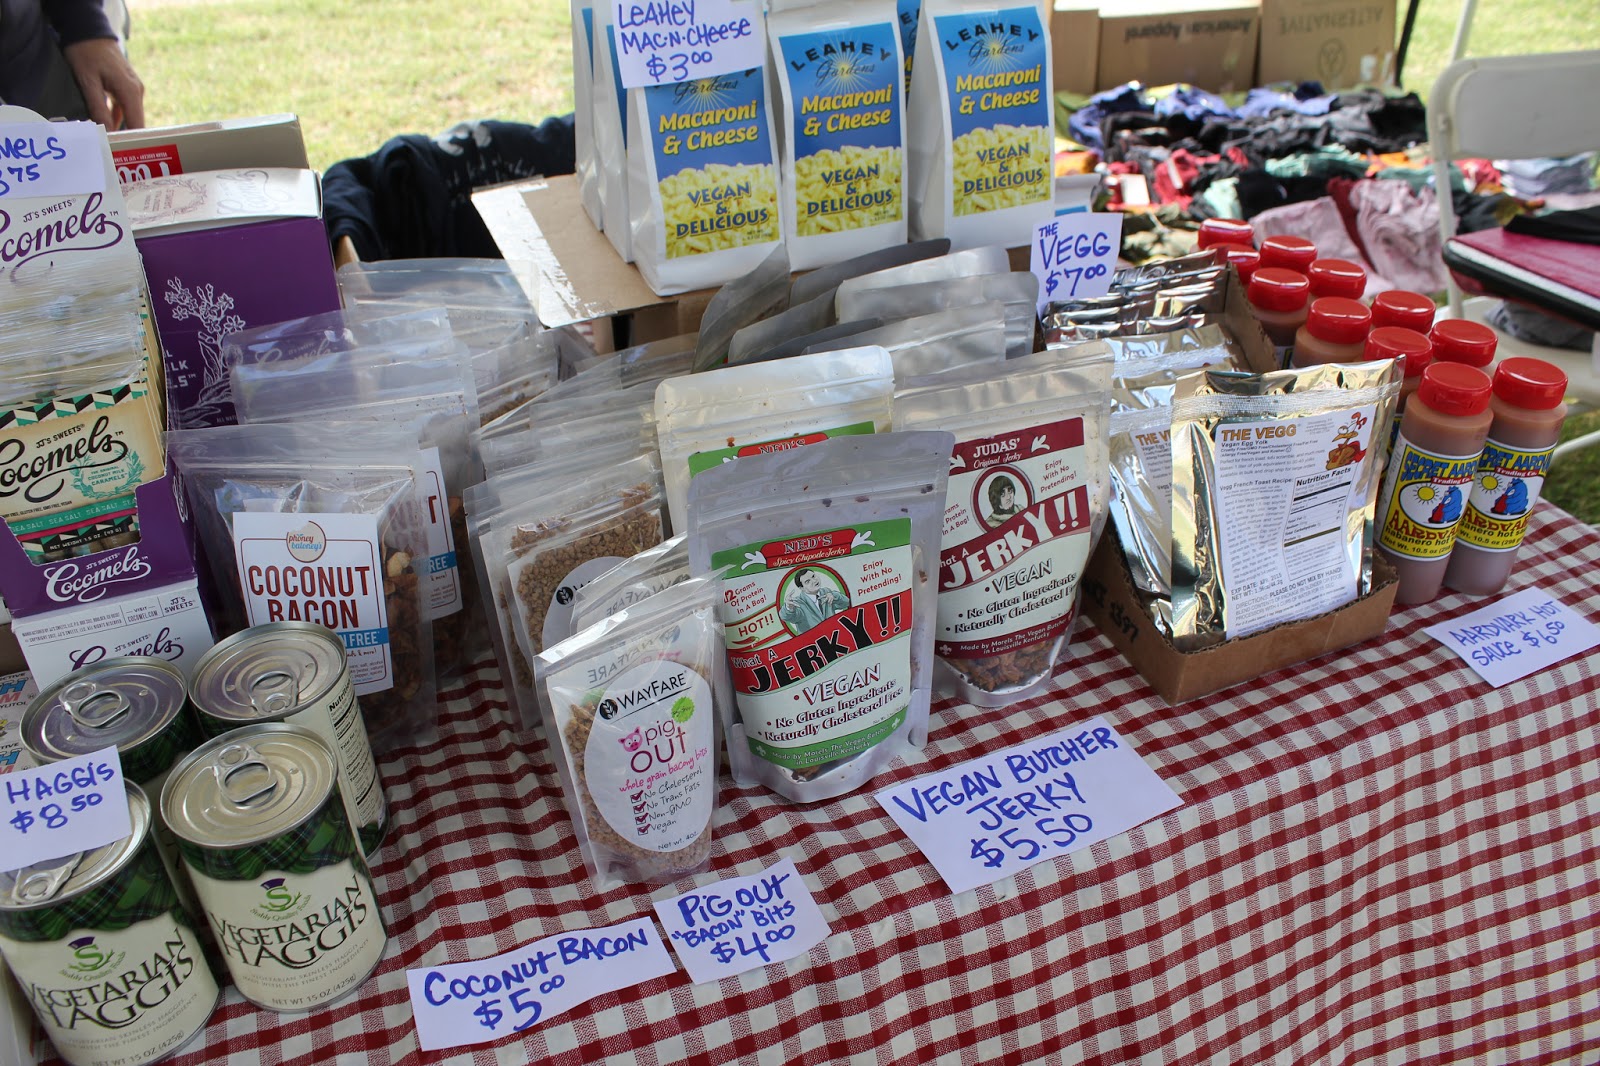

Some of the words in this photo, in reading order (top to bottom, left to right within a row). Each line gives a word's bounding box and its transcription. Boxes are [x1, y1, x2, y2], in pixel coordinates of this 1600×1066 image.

[1278, 6, 1385, 36] ALTERNATIVE
[945, 22, 1040, 51] LEAHEY
[790, 41, 892, 72] LEAHEY
[967, 39, 1025, 67] Gardens
[815, 57, 875, 88] Gardens
[955, 64, 1041, 93] Macaroni
[801, 84, 893, 115] Macaroni
[959, 95, 976, 114] &
[979, 88, 1040, 112] Cheese
[659, 100, 758, 134] Macaroni
[803, 117, 822, 136] &
[825, 108, 892, 133] Cheese
[663, 135, 682, 155] &
[686, 125, 759, 151] Cheese
[976, 142, 1030, 164] VEGAN
[821, 163, 880, 186] VEGAN
[963, 168, 1044, 196] DELICIOUS
[41, 198, 75, 216] SWEETS
[688, 181, 751, 206] VEGAN
[806, 189, 894, 217] DELICIOUS
[676, 207, 770, 239] DELICIOUS
[1038, 221, 1059, 238] THE
[1039, 231, 1111, 270] VEGG
[53, 424, 84, 442] SWEETS
[1221, 428, 1252, 441] THE
[1255, 423, 1297, 439] VEGG
[973, 438, 1021, 458] JUDAS'
[973, 456, 1001, 470] Original
[1003, 452, 1022, 464] Jerky
[1043, 470, 1059, 481] With
[1060, 464, 1070, 473] No
[1044, 457, 1063, 471] Enjoy
[1295, 473, 1330, 487] Nutrition
[1331, 466, 1352, 478] Facts
[1400, 450, 1448, 482] SECRET
[1495, 466, 1527, 478] Trading
[1040, 470, 1078, 494] Pretending!
[945, 507, 967, 524] Protein
[955, 515, 970, 529] Bag!
[784, 533, 833, 555] NED'S
[943, 490, 1080, 589] JERKY!!
[1384, 525, 1432, 547] habanero
[1497, 527, 1514, 537] hot
[772, 554, 794, 568] Spicy
[794, 549, 825, 564] Chipotle
[825, 546, 848, 558] Jerky
[862, 558, 885, 573] Enjoy
[961, 547, 970, 558] A
[43, 546, 152, 602] Cocomels
[248, 565, 370, 598] COCONUT
[734, 581, 757, 595] Grams
[857, 572, 902, 598] Pretending!
[859, 571, 880, 584] With
[880, 566, 893, 576] No
[992, 557, 1054, 595] VEGAN
[740, 587, 764, 603] Protein
[751, 594, 767, 607] Bag!
[967, 607, 985, 620] No
[985, 595, 1021, 614] Gluten
[1022, 571, 1078, 601] Ingredients
[1269, 585, 1288, 598] PLEASE
[164, 600, 194, 613] SWEETS
[266, 599, 359, 630] BACON
[954, 613, 1007, 634] Naturally
[1008, 592, 1064, 619] Cholesterol
[738, 613, 775, 637] HOT!!
[991, 636, 1014, 648] Morels
[1014, 632, 1026, 640] The
[1027, 626, 1046, 638] Vegan
[1046, 619, 1067, 631] Butcher
[1448, 611, 1536, 646] AARDVARK
[1528, 600, 1562, 620] HOT
[349, 631, 378, 646] FREE
[748, 594, 902, 695] JERKY!!
[991, 641, 1022, 654] Louisville
[1022, 631, 1051, 644] Kentucky
[730, 653, 762, 669] What
[767, 647, 779, 660] A
[616, 672, 687, 710] WAYFARE
[802, 662, 882, 706] VEGAN
[764, 721, 821, 742] Naturally
[822, 695, 885, 730] Cholesterol
[884, 685, 904, 704] Free
[775, 716, 795, 730] No
[796, 704, 836, 725] Gluten
[837, 678, 897, 711] Ingredients
[644, 718, 676, 746] pig
[803, 748, 829, 760] Morels
[830, 743, 843, 752] The
[844, 735, 866, 747] Vegan
[866, 726, 890, 739] Butcher
[805, 751, 839, 765] Louisville
[840, 741, 872, 756] Kentucky
[619, 778, 645, 792] whole
[646, 770, 668, 790] grain
[667, 756, 695, 775] bacony
[695, 747, 708, 761] bits
[644, 790, 656, 800] No
[658, 766, 703, 795] Cholesterol
[892, 764, 1003, 823] VEGAN
[1004, 726, 1119, 784] BUTCHER
[646, 801, 659, 811] No
[660, 791, 684, 806] Trans
[684, 780, 701, 795] Fats
[648, 796, 692, 821] Non-GMO
[966, 771, 1087, 831] JERKY
[651, 819, 677, 833] Vegan
[969, 813, 1093, 869] $5.50
[207, 873, 360, 946] VEGETARIAN
[219, 890, 368, 970] HAGGIS
[556, 927, 649, 966] BACON
[18, 926, 184, 1008] VEGETARIAN
[307, 994, 318, 1003] 15
[319, 988, 332, 998] OZ
[333, 973, 357, 993] (425g)
[129, 1053, 142, 1062] 15
[143, 1046, 156, 1058] OZ
[158, 1029, 185, 1052] (425g)
